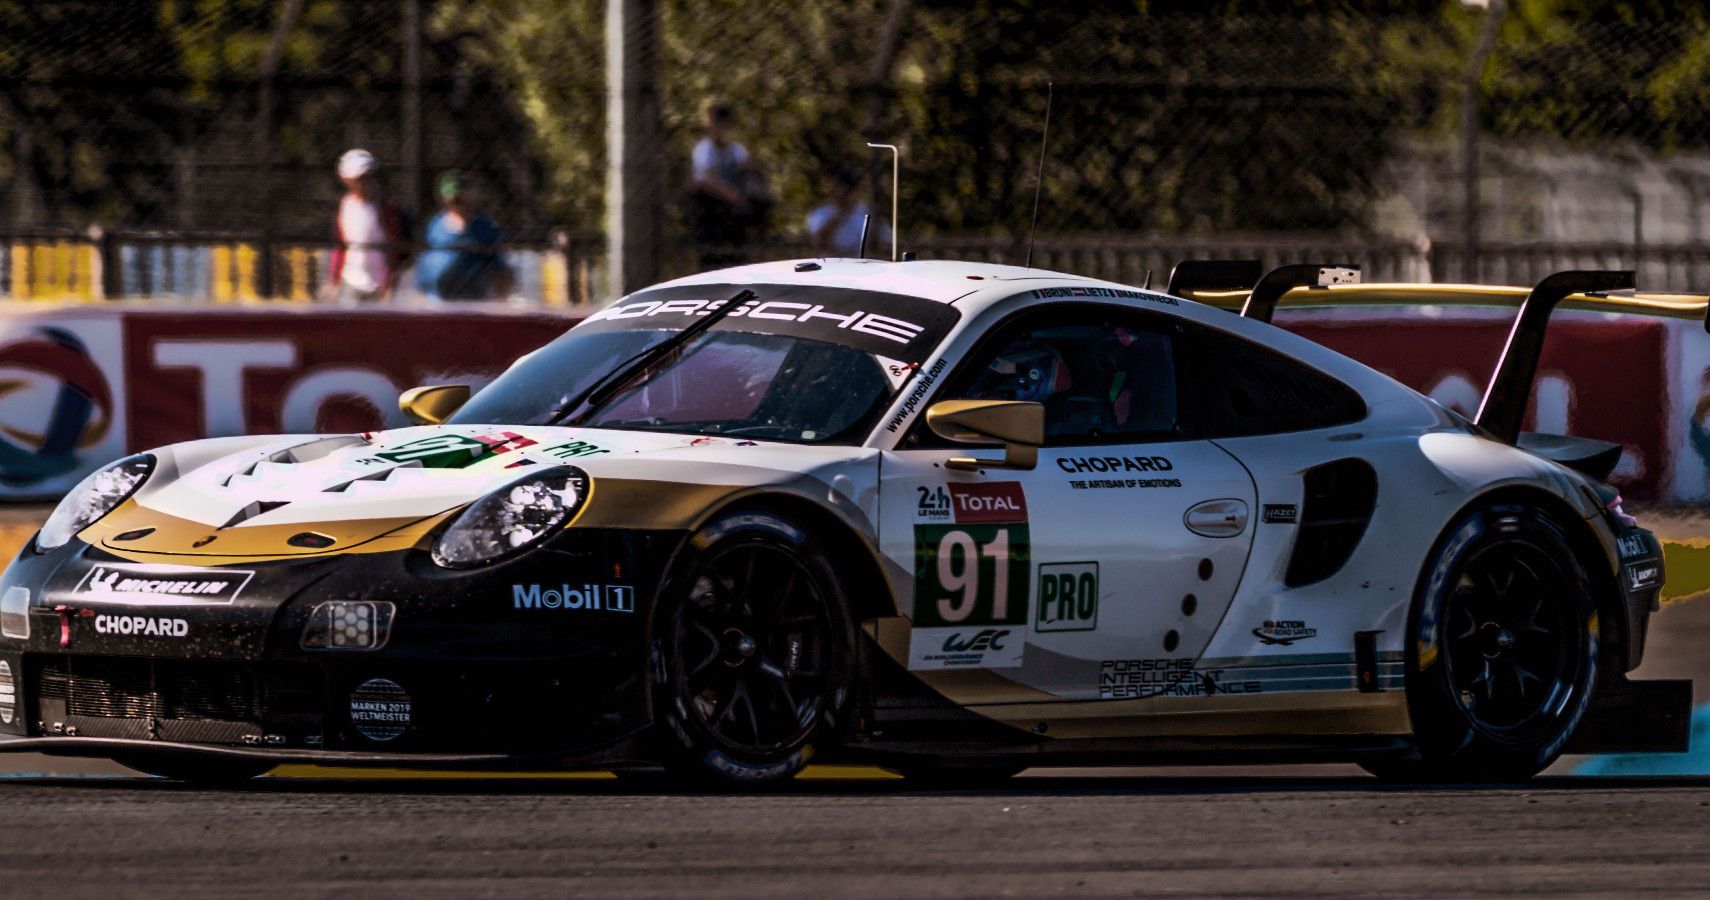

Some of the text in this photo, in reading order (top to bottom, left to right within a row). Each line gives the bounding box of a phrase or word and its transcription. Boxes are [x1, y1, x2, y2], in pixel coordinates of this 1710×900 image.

[887, 358, 947, 433] www.porsche.com
[1056, 456, 1173, 473] CHOPARD
[1069, 478, 1182, 489] THE ARTISAN OF EMOTIONS
[955, 493, 1020, 511] TOTAL
[937, 529, 1010, 622] 91
[115, 578, 228, 594] MICHELIN
[512, 584, 601, 609] Mobil
[1040, 572, 1096, 622] PRO
[95, 615, 188, 637] CHOPARD
[942, 629, 1011, 652] WEC
[1101, 658, 1194, 672] PORSCHE
[1100, 670, 1225, 684] INTELLIGENT
[351, 702, 411, 712] MARKEN 2019
[351, 711, 411, 721] WELTMEISTER
